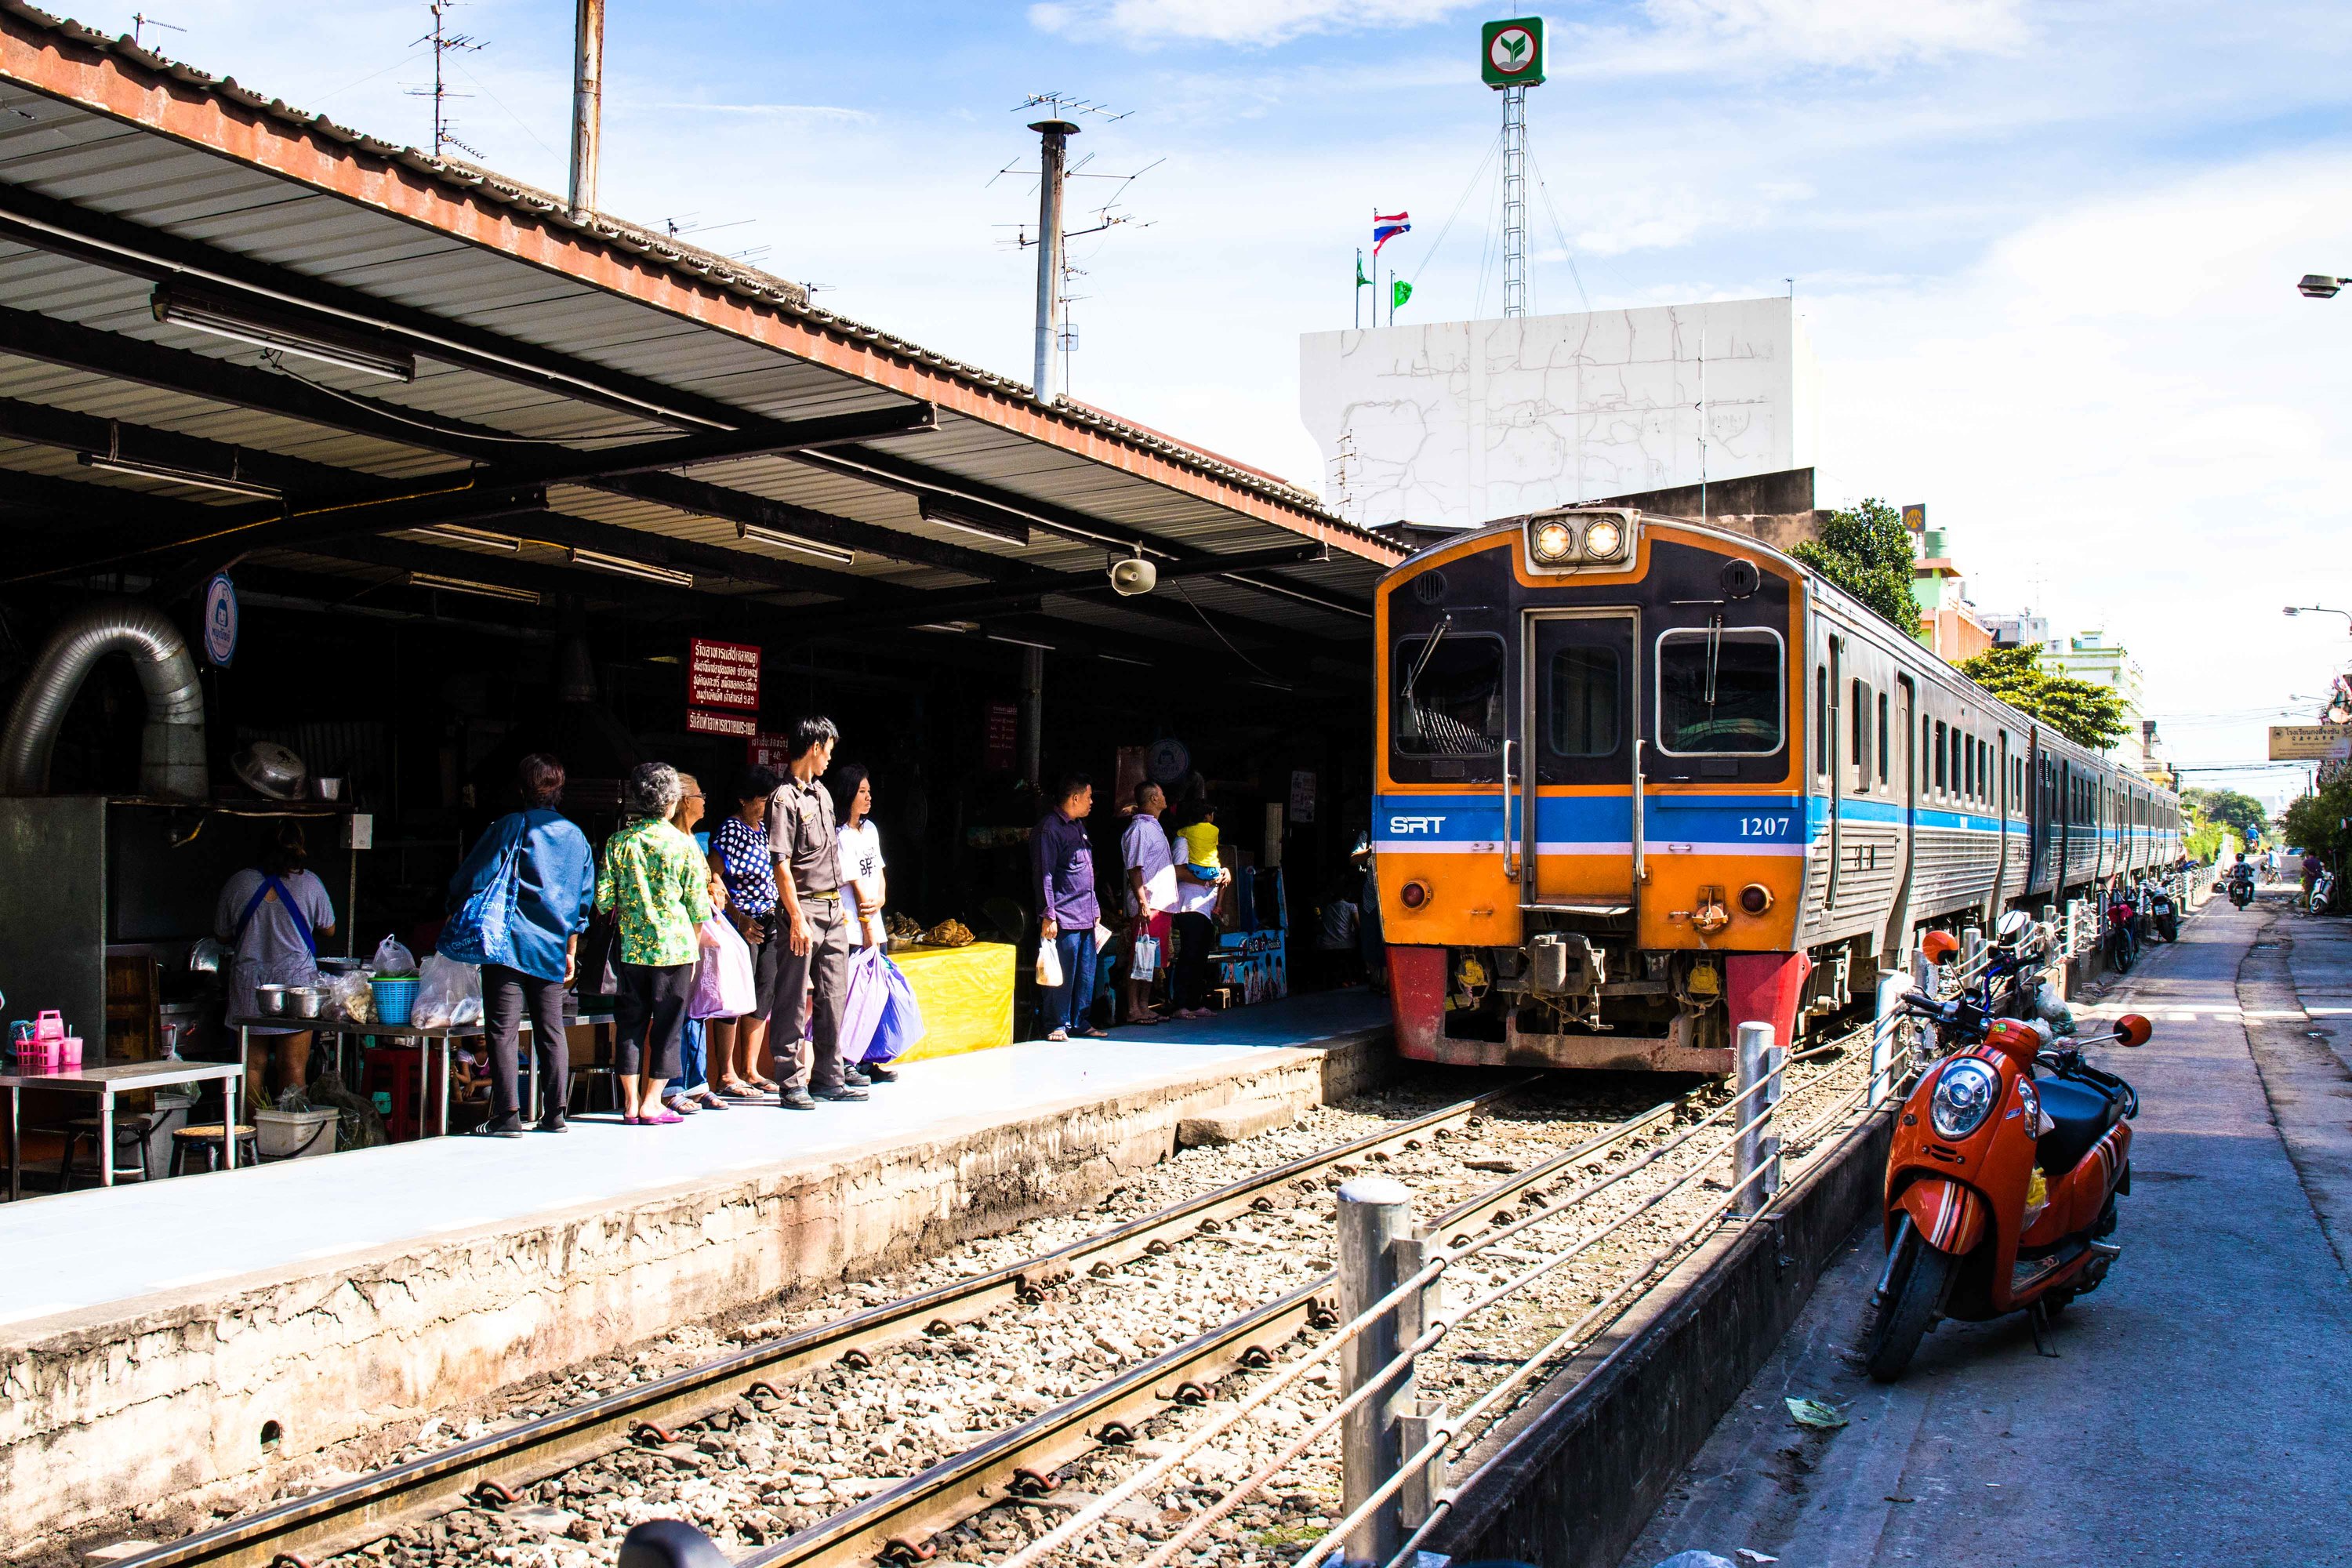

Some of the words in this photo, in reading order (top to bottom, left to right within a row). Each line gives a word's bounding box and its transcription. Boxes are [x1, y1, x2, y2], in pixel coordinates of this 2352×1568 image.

[1389, 816, 1446, 834] SRT
[1739, 817, 1790, 837] 1207
[481, 902, 510, 913] CENTRA
